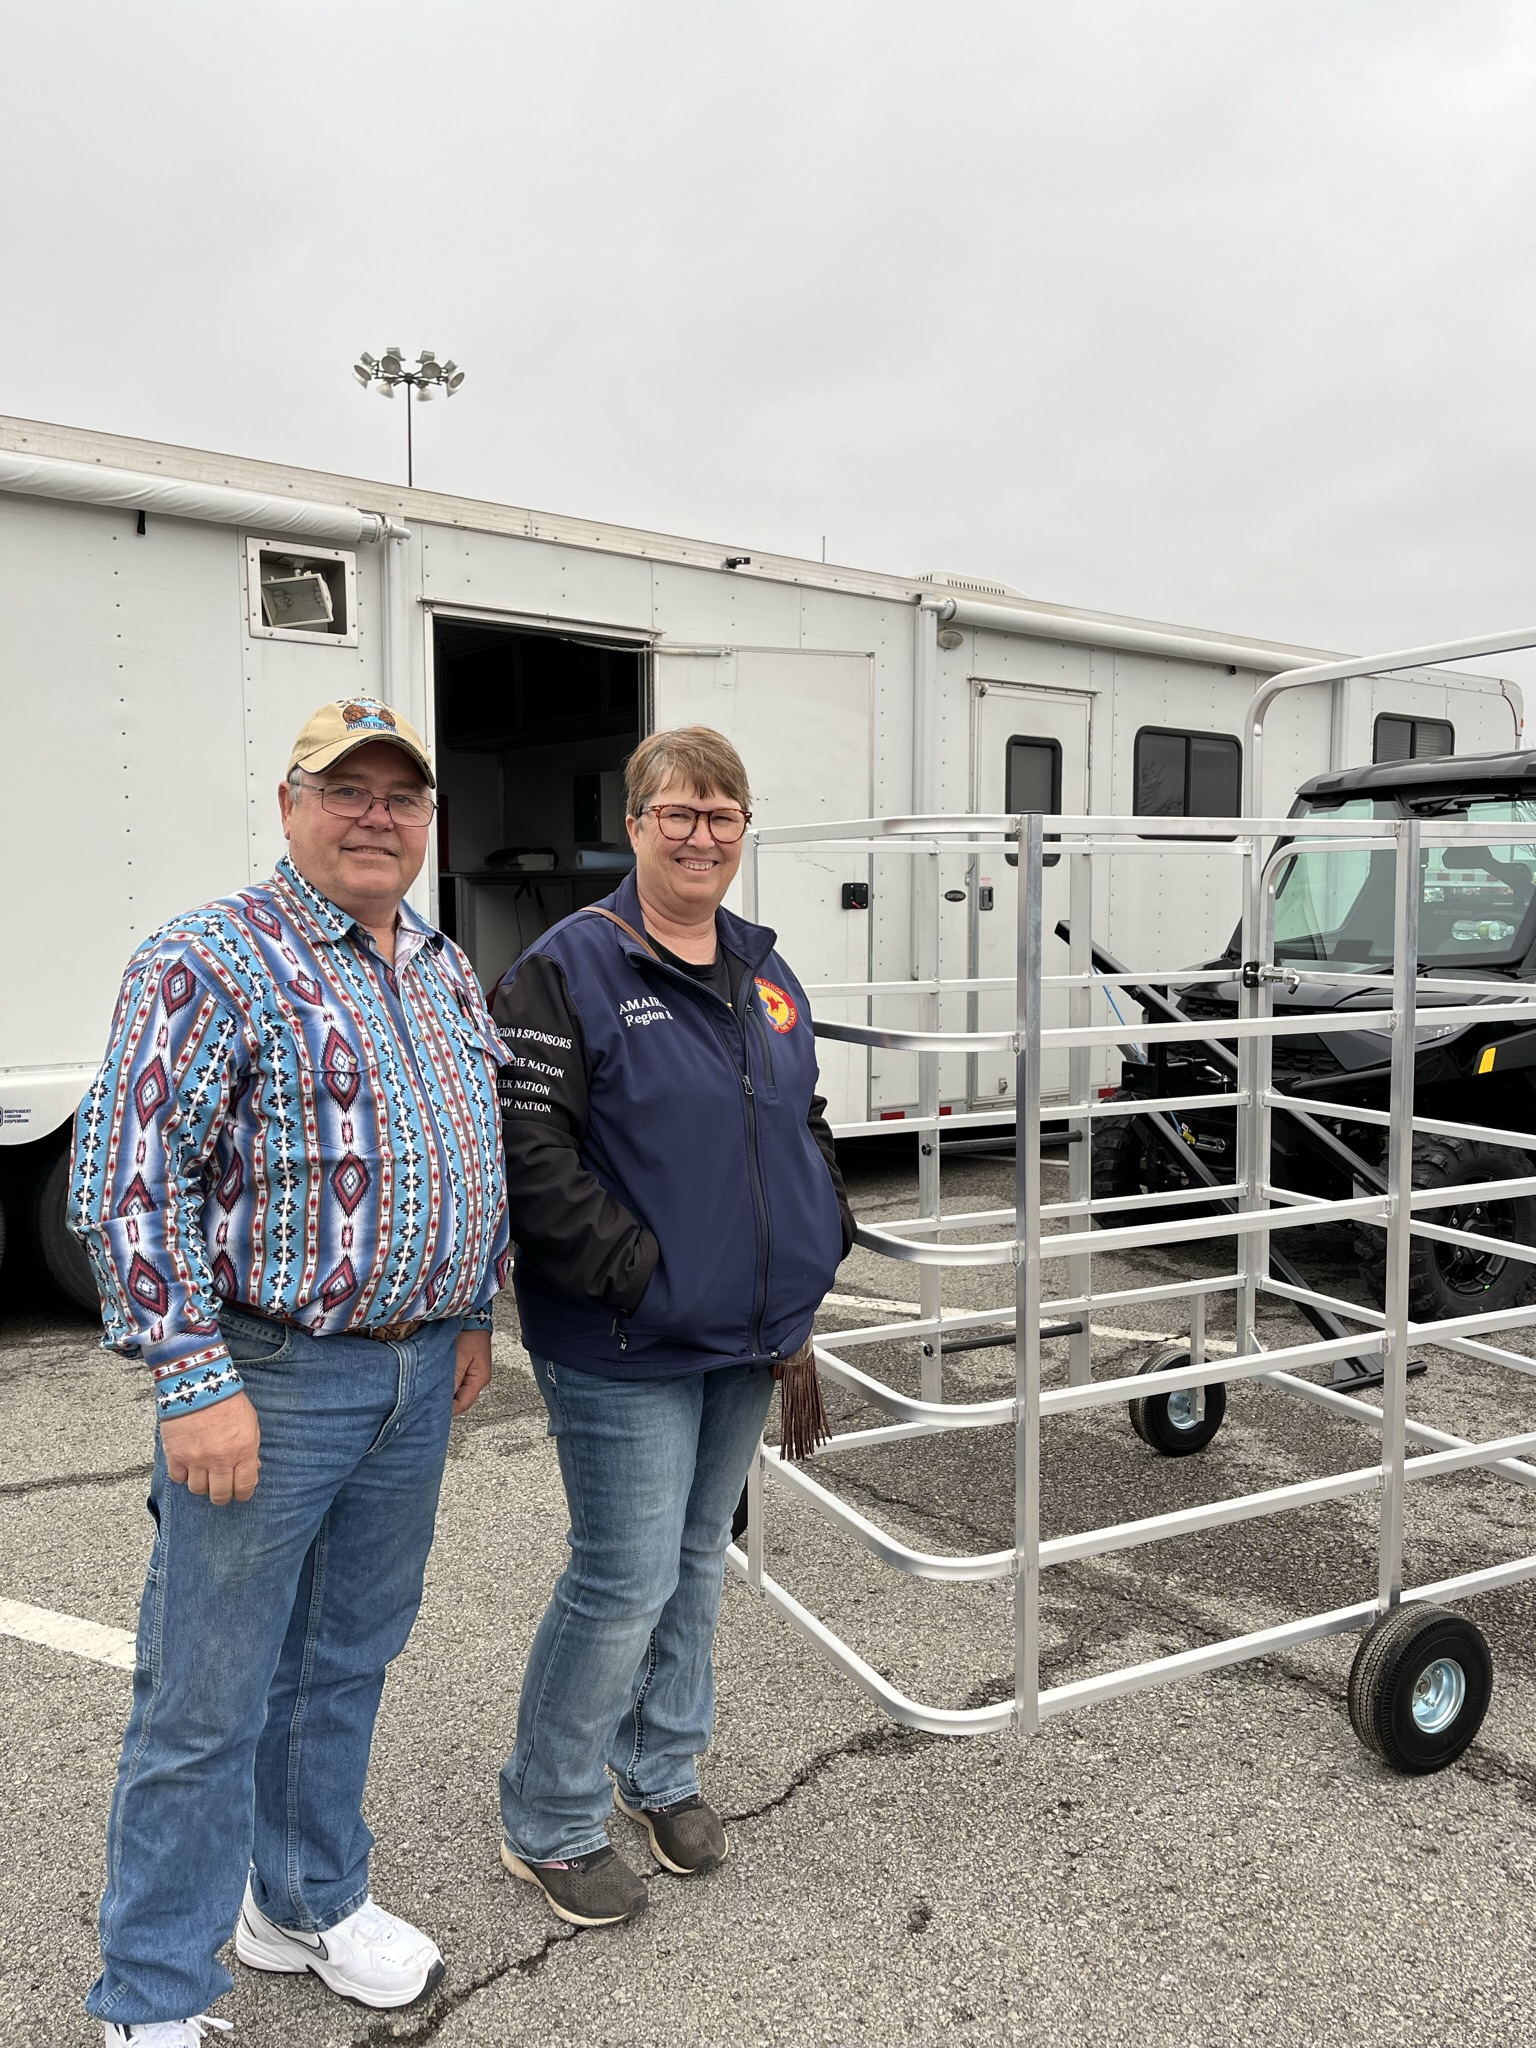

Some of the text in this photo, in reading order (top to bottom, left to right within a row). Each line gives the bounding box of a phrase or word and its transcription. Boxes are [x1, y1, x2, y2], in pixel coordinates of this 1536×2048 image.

[624, 1010, 666, 1027] Region
[516, 1028, 523, 1038] 8
[522, 1028, 572, 1050] SPONSORS
[527, 1059, 565, 1079] NATION
[497, 1079, 551, 1096] EEK NATION
[499, 1097, 552, 1114] AW NATION
